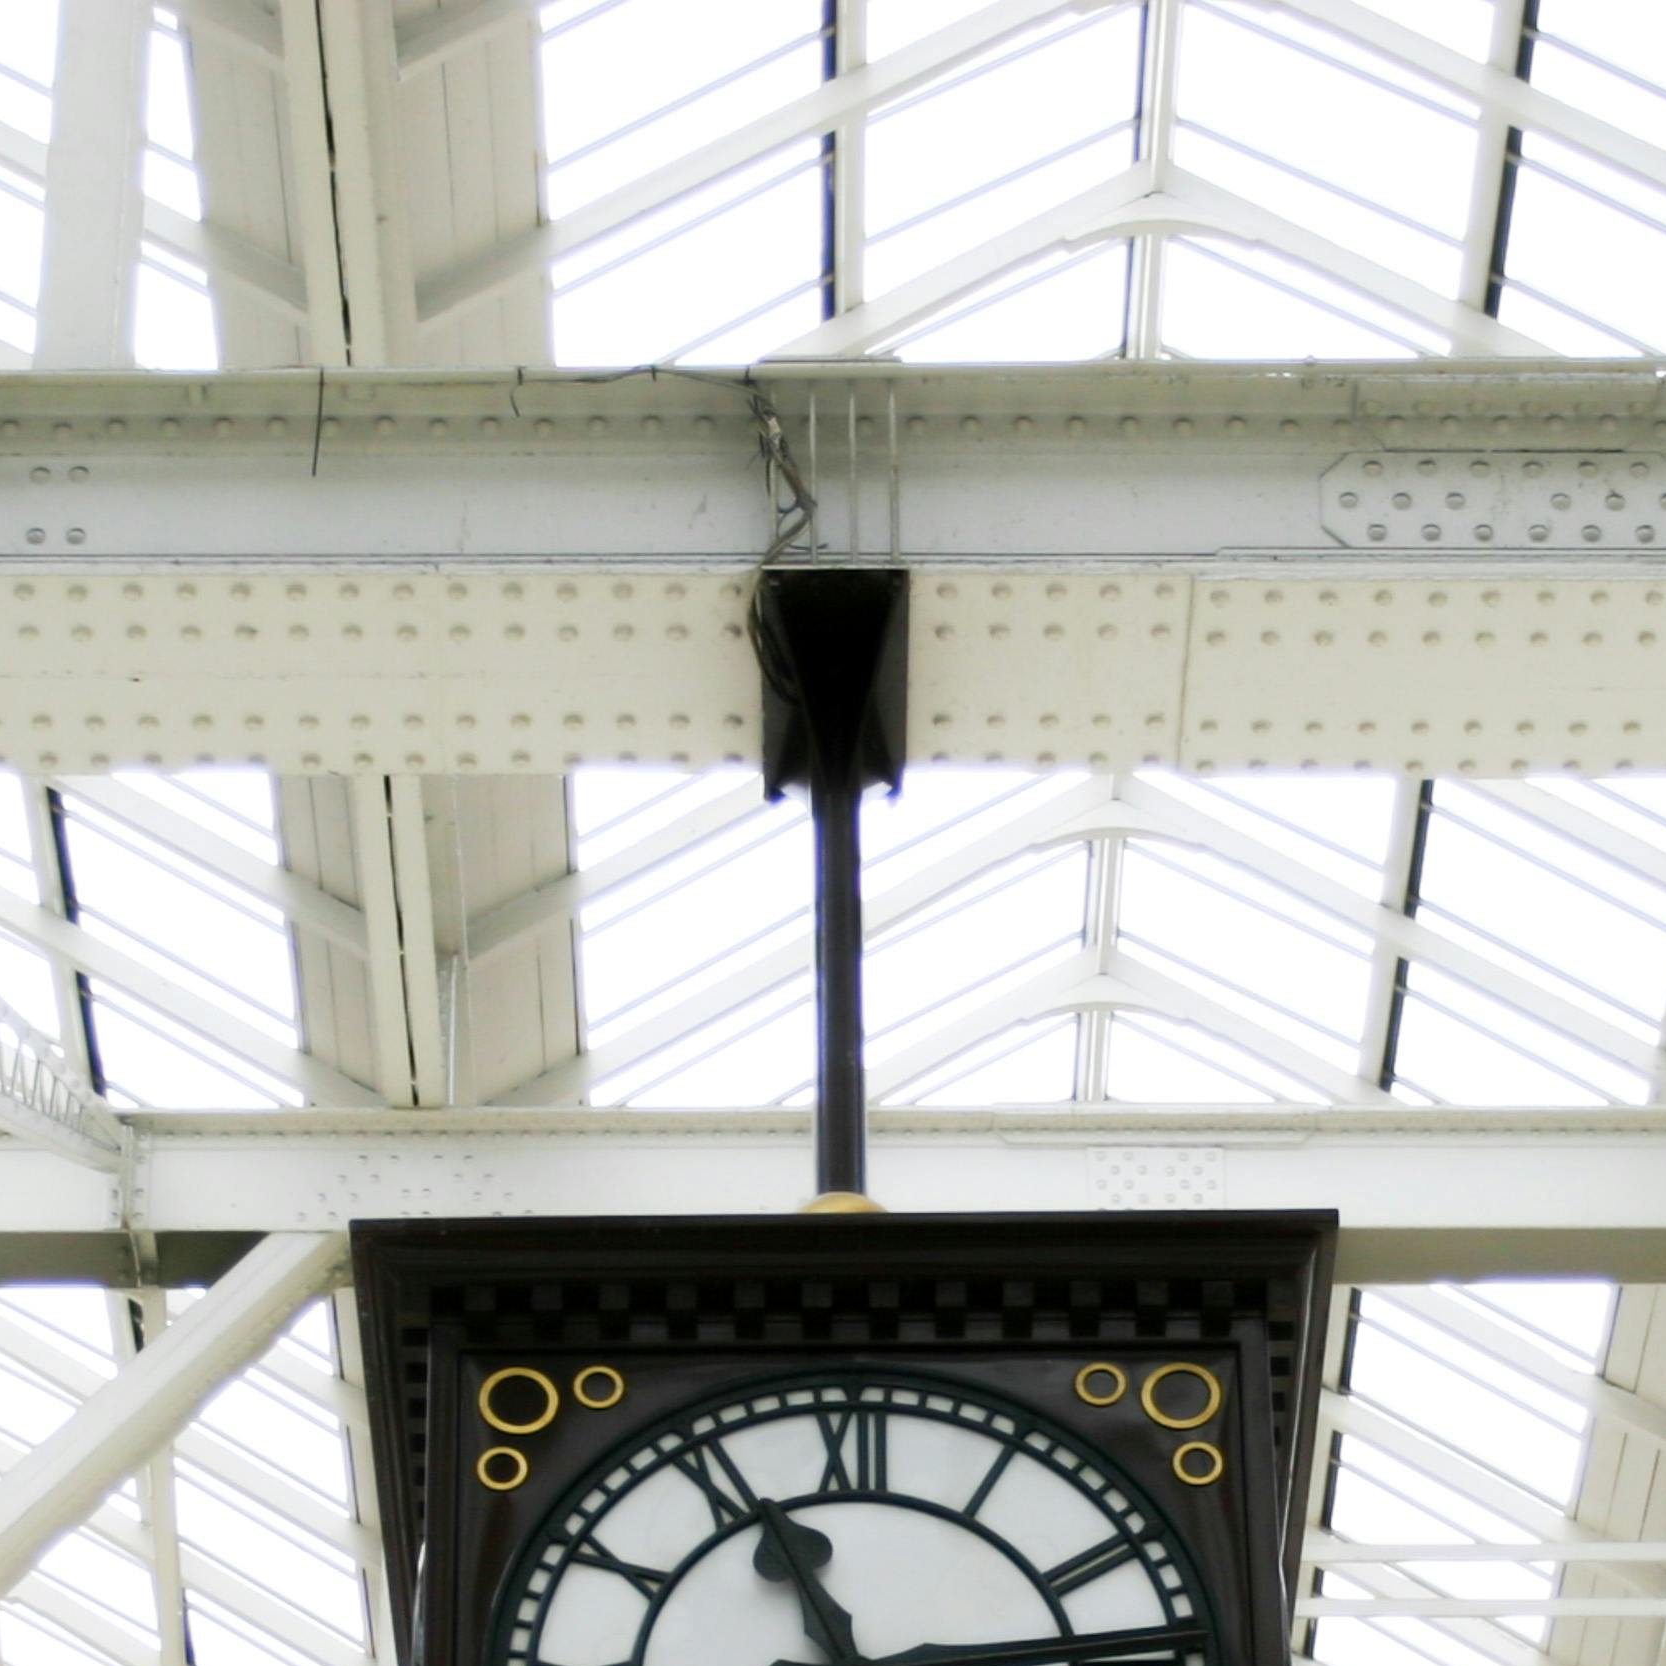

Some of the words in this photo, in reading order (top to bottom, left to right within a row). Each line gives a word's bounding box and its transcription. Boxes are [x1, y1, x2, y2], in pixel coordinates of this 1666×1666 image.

[672, 1440, 760, 1530] XI
[816, 1410, 887, 1493] XII
[961, 1441, 1016, 1518] I
[569, 1534, 674, 1599] X
[1041, 1534, 1137, 1597] II
